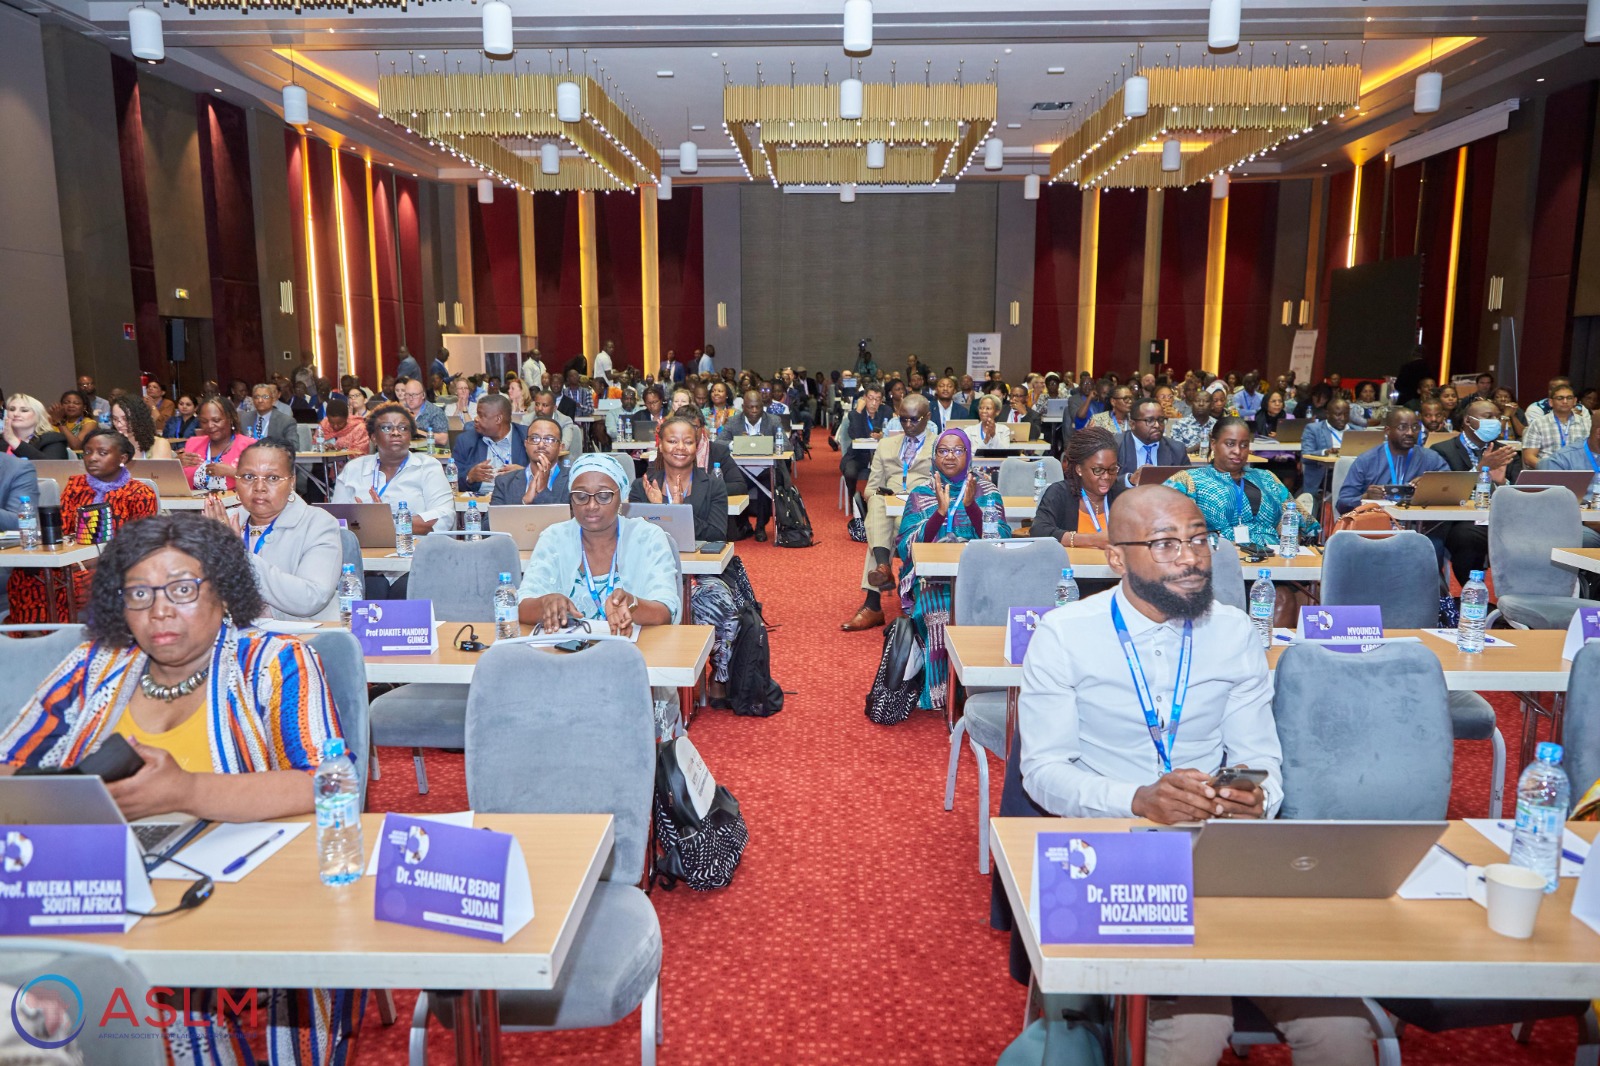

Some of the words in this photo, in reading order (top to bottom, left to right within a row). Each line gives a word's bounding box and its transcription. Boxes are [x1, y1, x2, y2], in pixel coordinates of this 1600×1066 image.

[365, 628, 379, 637] Prof
[379, 628, 402, 637] DIAKITE
[402, 627, 429, 636] MANDIOU
[407, 635, 429, 644] GUINEA
[1347, 626, 1381, 636] MVOUNDZA
[1361, 643, 1380, 653] GAB
[27, 880, 72, 897] KOLEKA
[73, 880, 123, 896] MLISANA
[396, 865, 412, 886] Dr.
[413, 868, 467, 895] SHAHINAZ
[467, 877, 501, 901] BEDRI
[1087, 884, 1108, 903] Dr.
[1110, 884, 1146, 903] FELIX
[1147, 884, 1188, 903] PINTO
[42, 896, 81, 914] SOUTH
[82, 896, 122, 913] AFRICA
[461, 897, 499, 920] SUDAN
[1100, 903, 1189, 923] MOZAMBIQUE
